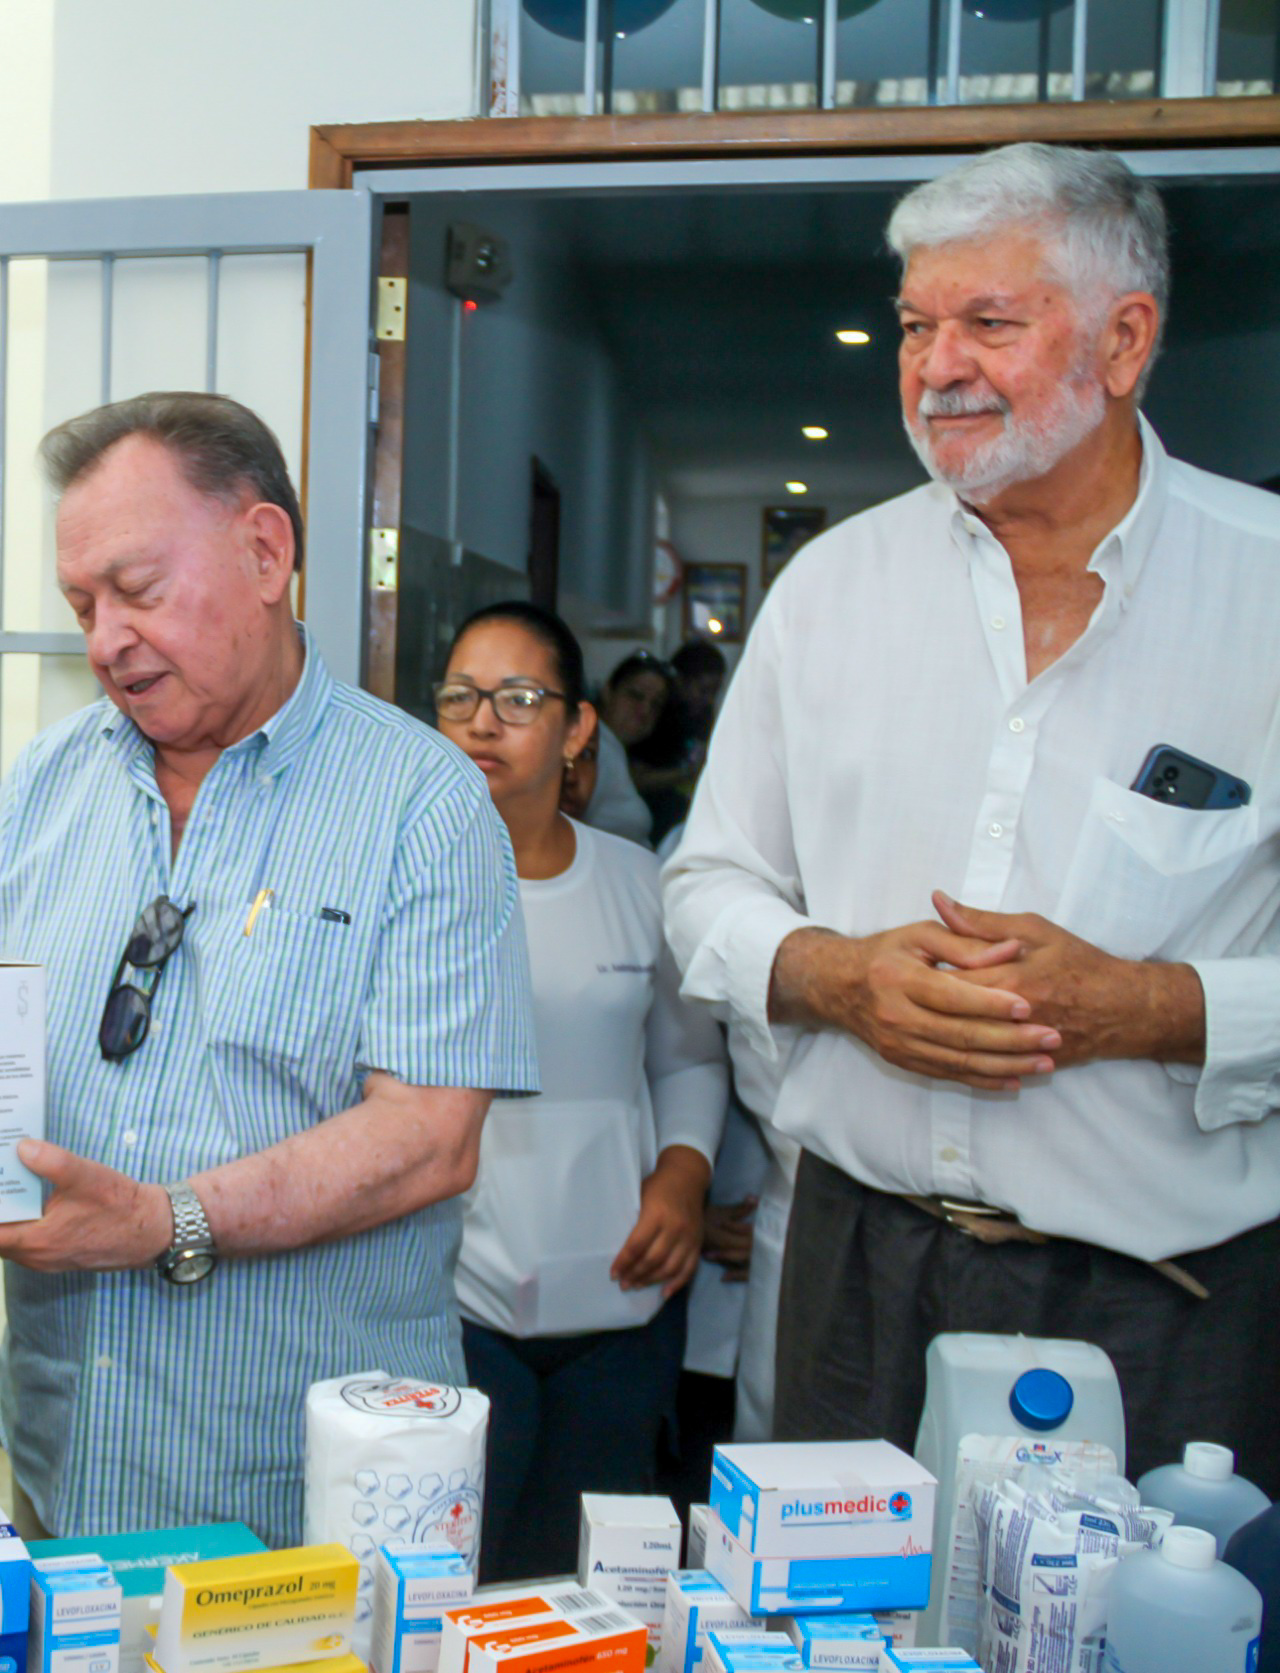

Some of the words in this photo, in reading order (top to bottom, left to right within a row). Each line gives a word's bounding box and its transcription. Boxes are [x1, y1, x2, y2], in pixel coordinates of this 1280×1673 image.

[781, 1496, 888, 1520] plusmedic
[196, 1576, 304, 1606] Omeprazol
[408, 1590, 468, 1601] LEVOFLOXACINA
[56, 1603, 117, 1617] LEVOFLOXACINA
[256, 1621, 271, 1630] DE
[275, 1613, 326, 1627] CALIDAD
[813, 1654, 880, 1666] LEVOFLOXACINA
